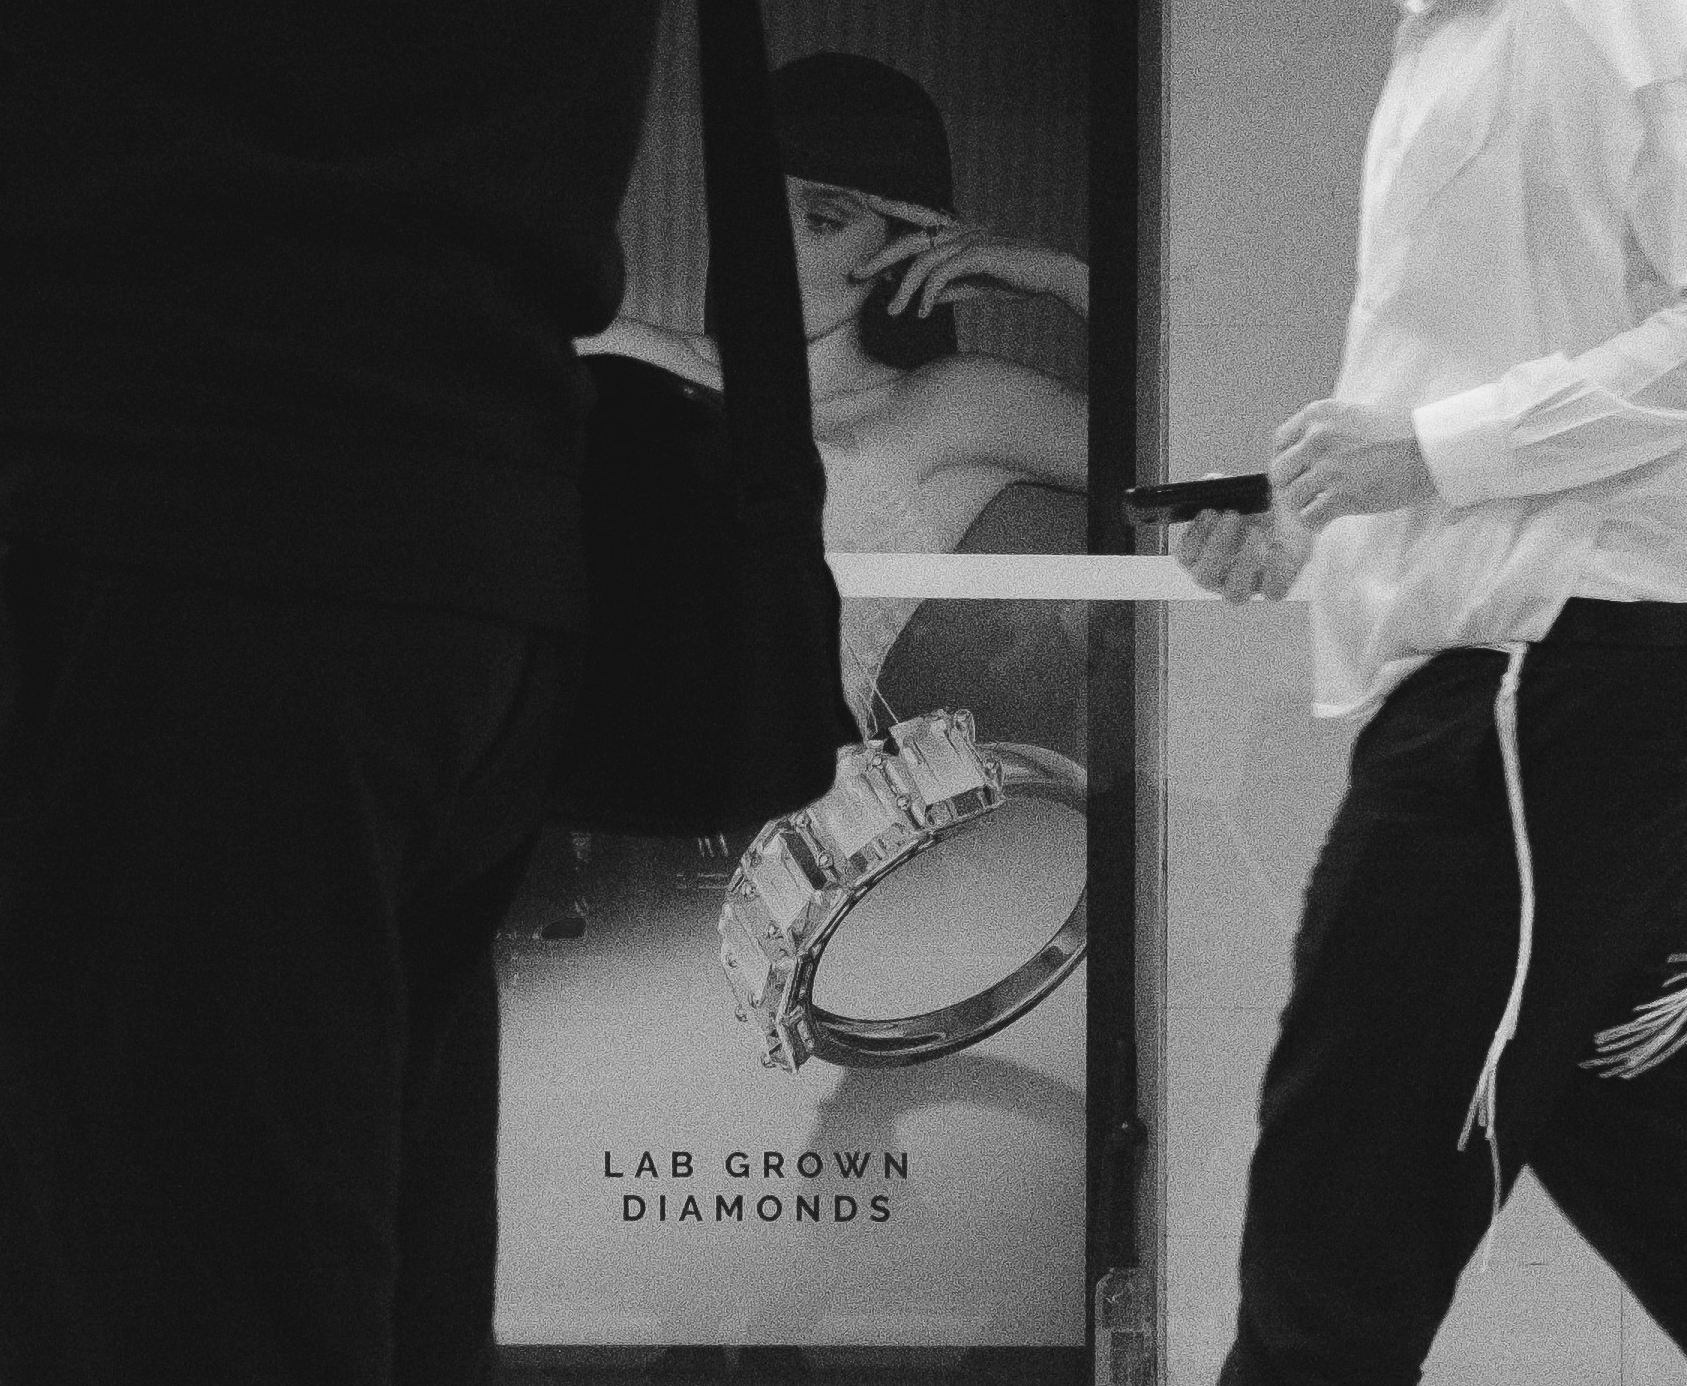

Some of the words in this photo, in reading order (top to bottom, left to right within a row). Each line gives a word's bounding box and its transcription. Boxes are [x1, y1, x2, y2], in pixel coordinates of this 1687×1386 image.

[604, 1151, 695, 1179] LAB
[725, 1150, 910, 1180] GROWN
[622, 1194, 892, 1224] DIAMONDS
